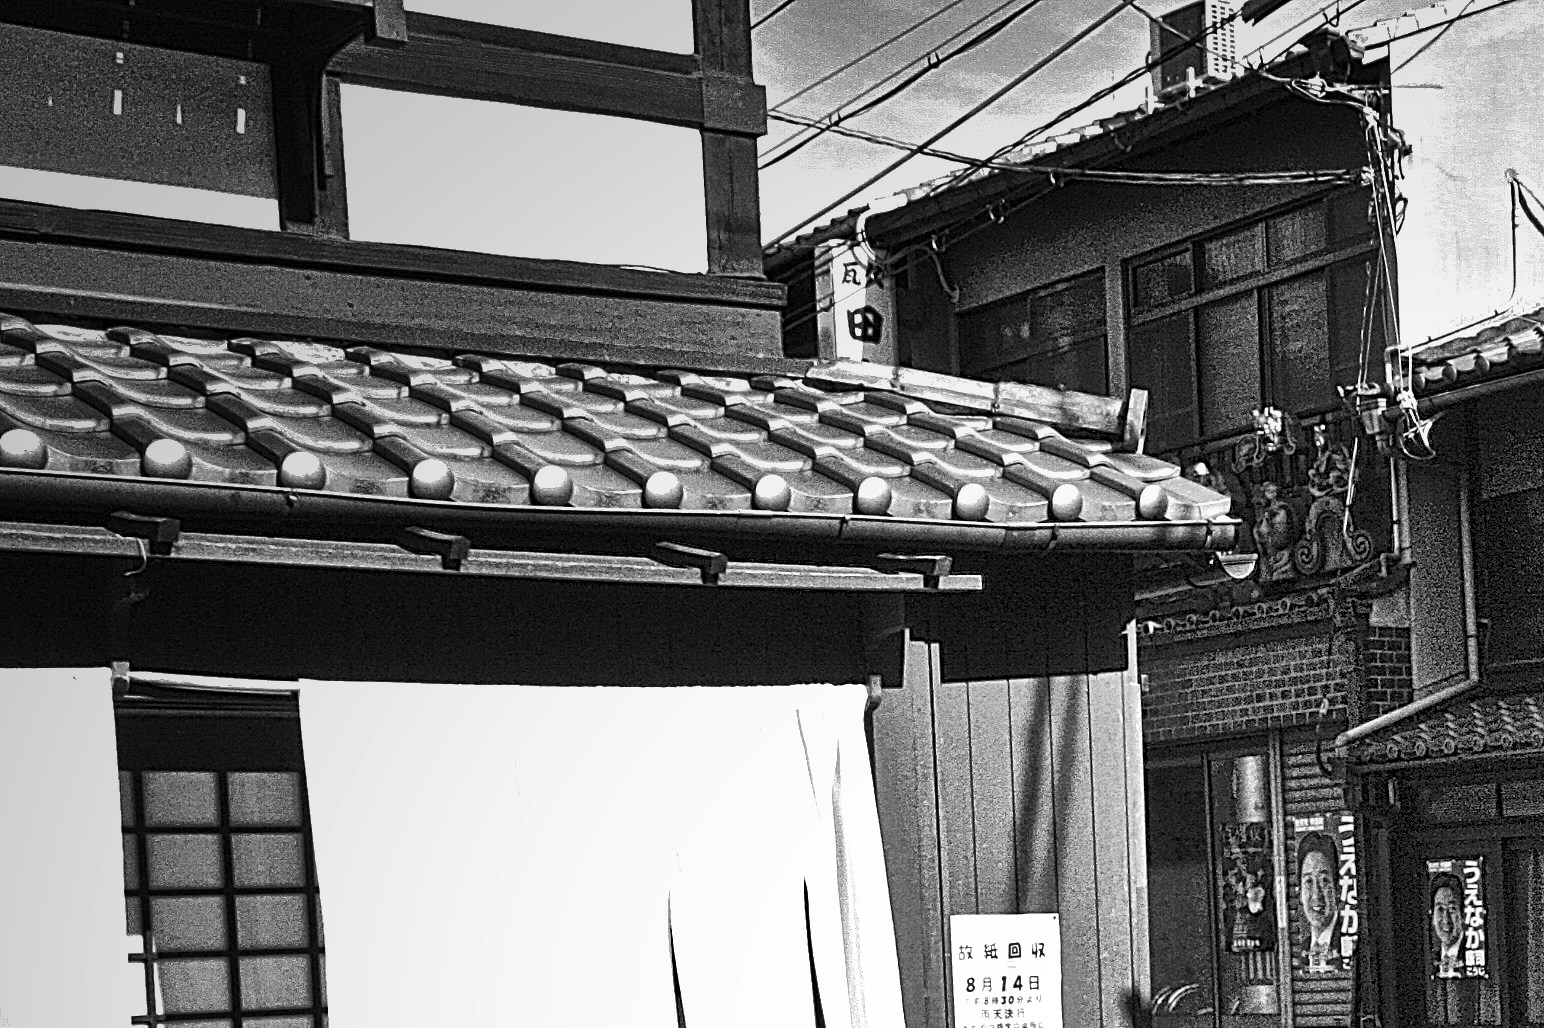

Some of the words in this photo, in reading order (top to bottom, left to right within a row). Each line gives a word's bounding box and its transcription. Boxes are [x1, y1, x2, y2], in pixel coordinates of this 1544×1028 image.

[959, 942, 1045, 960] 故紙回収
[966, 975, 1040, 993] 8月14日
